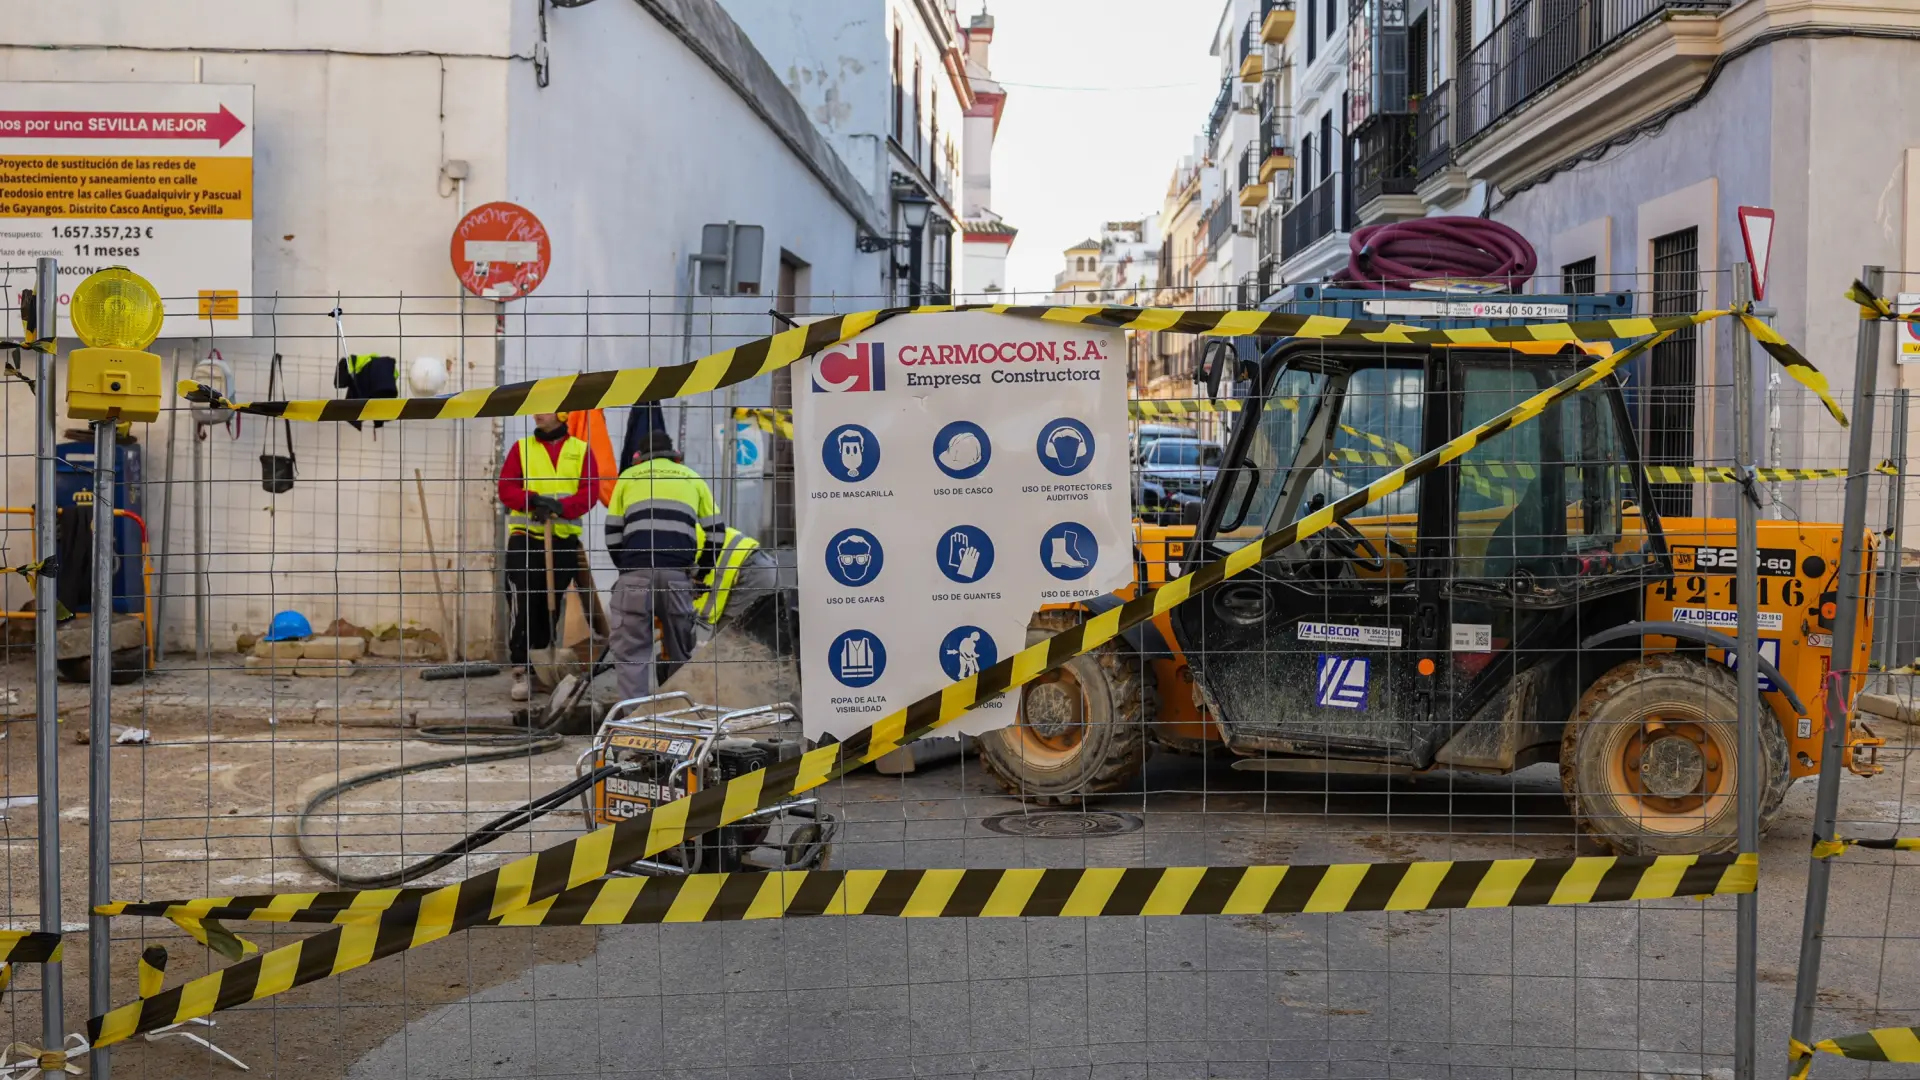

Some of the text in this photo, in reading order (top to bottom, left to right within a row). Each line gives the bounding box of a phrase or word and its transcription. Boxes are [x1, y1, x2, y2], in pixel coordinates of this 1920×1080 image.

[25, 120, 50, 134] por
[54, 120, 83, 131] una
[88, 117, 148, 131] SEVILLA
[152, 118, 207, 132] MEJOR
[46, 158, 59, 168] de
[61, 158, 118, 169] sustitución
[121, 159, 133, 169] de
[136, 159, 150, 169] las
[153, 160, 180, 169] redes
[184, 160, 196, 169] de
[80, 176, 87, 187] y
[89, 174, 156, 185] saneamiento
[158, 176, 171, 185] en
[173, 174, 198, 185] calle
[46, 189, 74, 199] entre
[77, 189, 91, 199] las
[94, 189, 122, 199] calles
[125, 189, 191, 202] Guadalquivir
[194, 191, 200, 202] y
[202, 190, 242, 200] Pascual
[13, 204, 66, 216] Gayangos.
[69, 203, 107, 214] Distrito
[110, 204, 139, 214] Casco
[142, 204, 186, 217] Antiguo,
[189, 204, 223, 215] Sevilla
[52, 226, 141, 240] 1.657.357,23
[145, 226, 154, 239] €
[17, 248, 26, 256] de
[27, 248, 64, 258] ejecución:
[74, 244, 90, 256] 11
[94, 246, 140, 257] meses
[1484, 304, 1503, 315] 954
[1506, 305, 1518, 315] 40
[1521, 305, 1533, 315] 50
[1536, 306, 1548, 316] 21
[907, 368, 1101, 388] Empresa Constructora
[933, 488, 950, 496] USO
[965, 487, 994, 495] CASCO
[1022, 483, 1113, 493] USO DE PROTECTORES
[811, 490, 894, 499] USO DE MASCARILLA
[1046, 494, 1089, 502] AUDITIVOS
[1696, 548, 1792, 570] 52-60
[932, 592, 1002, 602] USO DE GUANTES
[1041, 590, 1058, 598] USO
[1072, 589, 1100, 597] BOTAS
[826, 597, 843, 605] USO
[858, 596, 885, 604] GAFAS
[1689, 610, 1738, 622] LOBCOR
[1313, 625, 1360, 637] LOBCOR
[831, 697, 851, 705] ROPA
[835, 705, 882, 713] VISIBILIDAD
